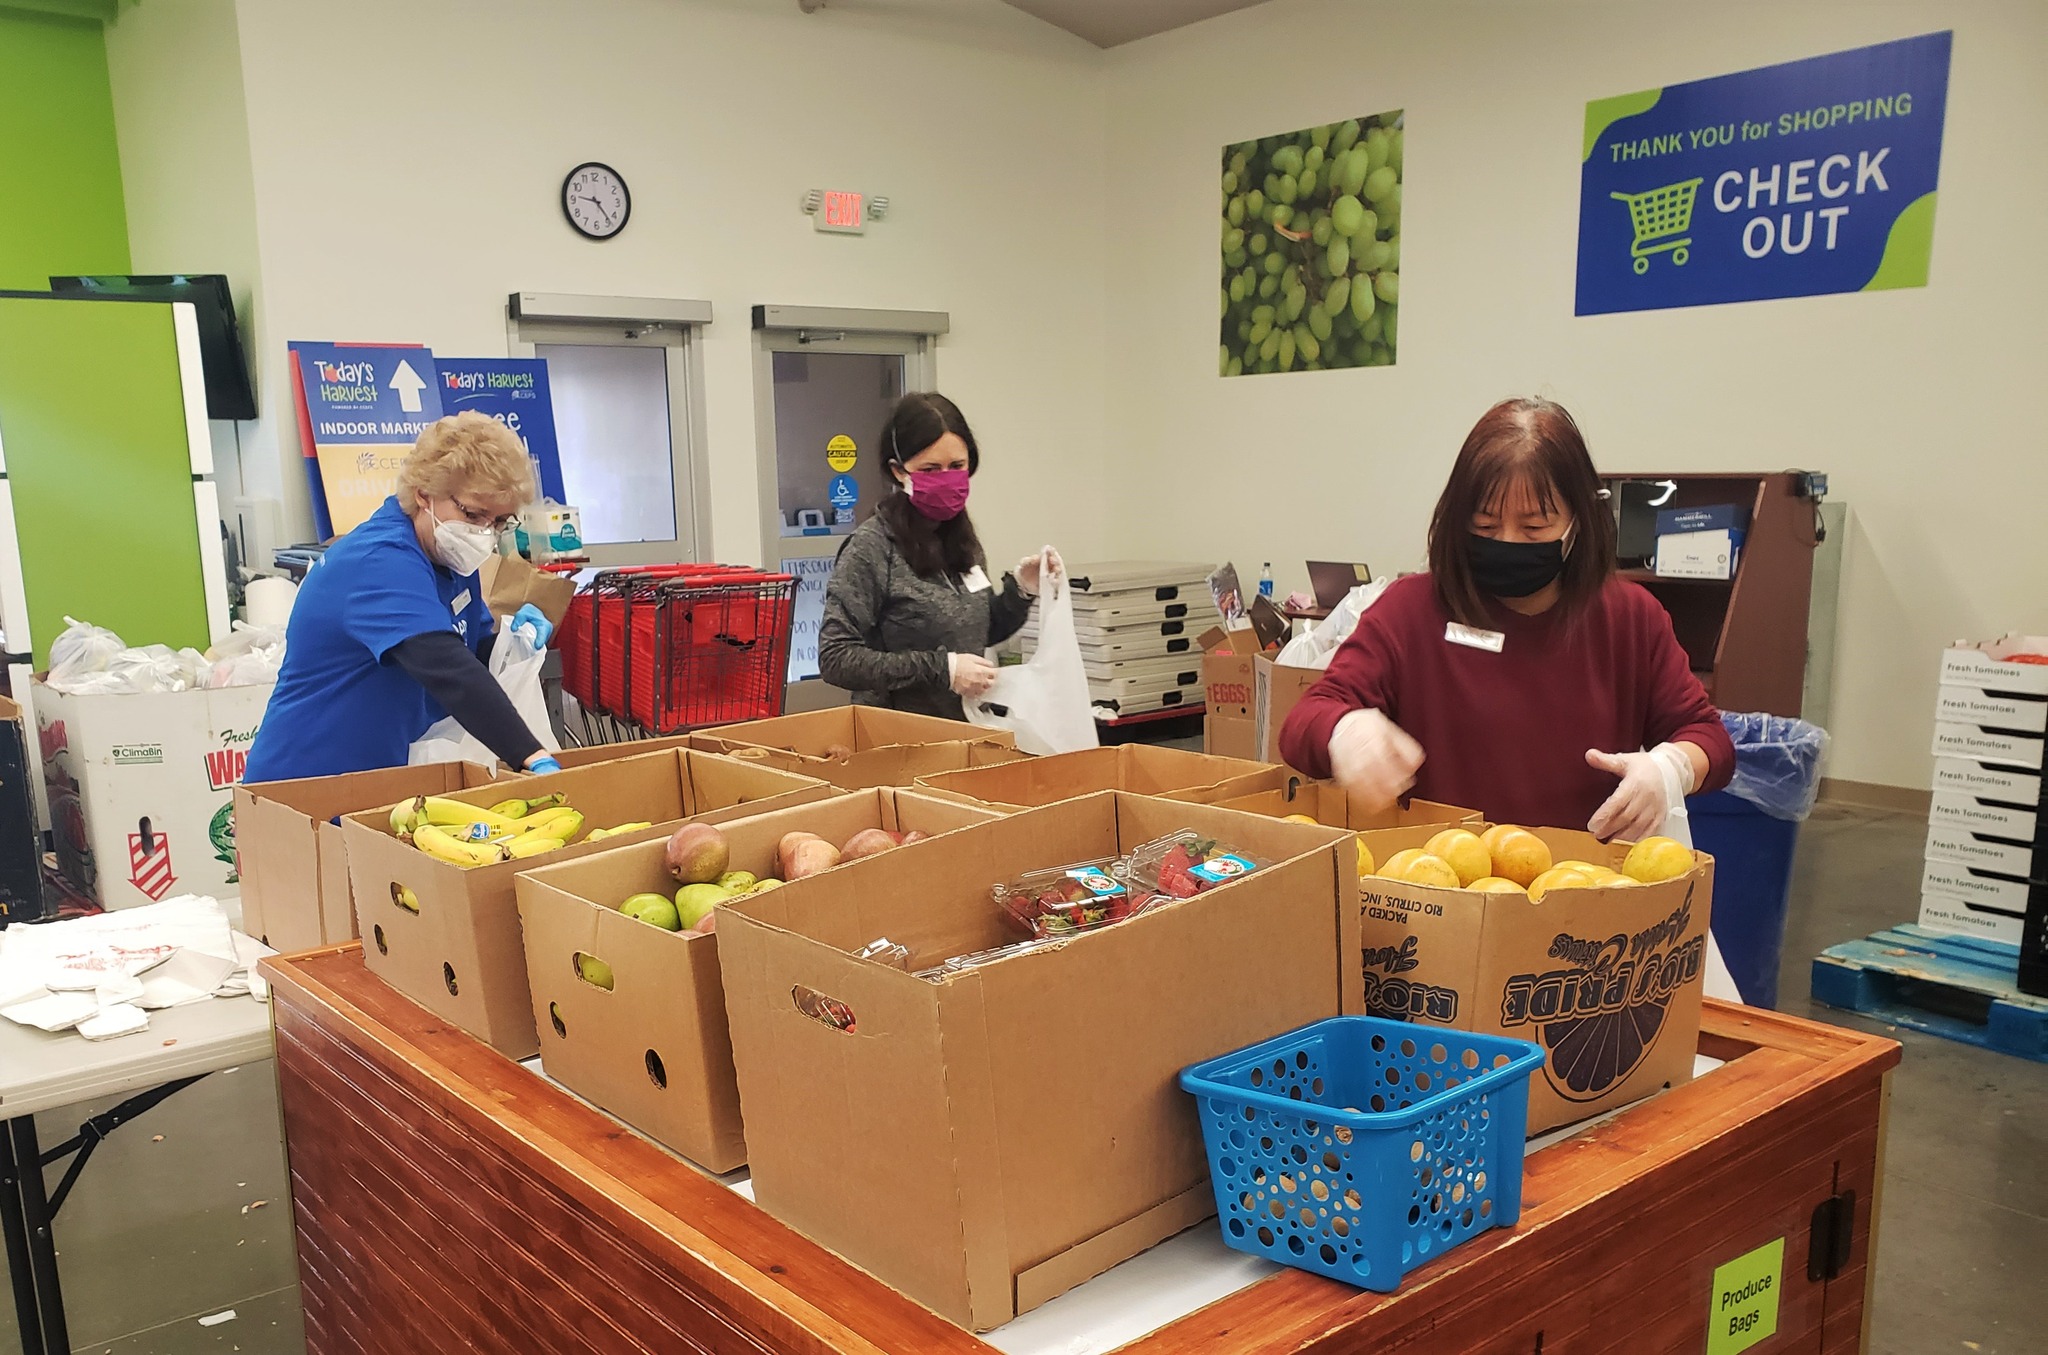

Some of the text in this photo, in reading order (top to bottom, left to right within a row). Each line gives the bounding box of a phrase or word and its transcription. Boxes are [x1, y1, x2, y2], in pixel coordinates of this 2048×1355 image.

[1610, 93, 1913, 163] THANK YOU for SHOPPING
[581, 174, 588, 184] 11
[590, 172, 599, 182] 12
[1712, 147, 1891, 214] CHECK
[573, 182, 582, 192] 10
[611, 185, 617, 195] 2
[570, 194, 576, 204] 9
[615, 198, 620, 208] 3
[575, 208, 580, 218] 8
[611, 211, 617, 219] 4
[825, 191, 863, 227] EXIT
[583, 216, 589, 226] 7
[594, 220, 600, 230] 6
[1741, 206, 1850, 259] OUT
[320, 422, 429, 435] INDOOR MARKE
[1946, 663, 2020, 677] Fresh Tomatoes
[1212, 683, 1246, 703] EGGS
[1943, 699, 2016, 713] Fresh Tomatoes
[1939, 735, 2012, 750] Fresh Tomatoes
[121, 747, 163, 757] ClimaBin
[1940, 771, 1963, 780] Fresh
[1966, 773, 2012, 786] Tomatoes
[1936, 805, 1960, 815] Fresh
[1963, 809, 2008, 822] Tomatoes
[1932, 840, 1956, 850] Fresh
[1959, 844, 2004, 858] Tomatoes
[1928, 874, 1952, 885] Fresh
[1955, 879, 2000, 893] Tomatoes
[1385, 895, 1422, 912] CITRUS,
[1424, 903, 1443, 916] RIO
[1369, 907, 1408, 924] PACKED
[1926, 908, 1949, 918] Fresh
[1952, 912, 1997, 928] Tomatoes
[1548, 933, 1629, 975] Citrus
[1500, 935, 1704, 1028] RIO'S PRIDE
[1721, 1274, 1772, 1312] Produce
[1728, 1309, 1759, 1337] Bags
